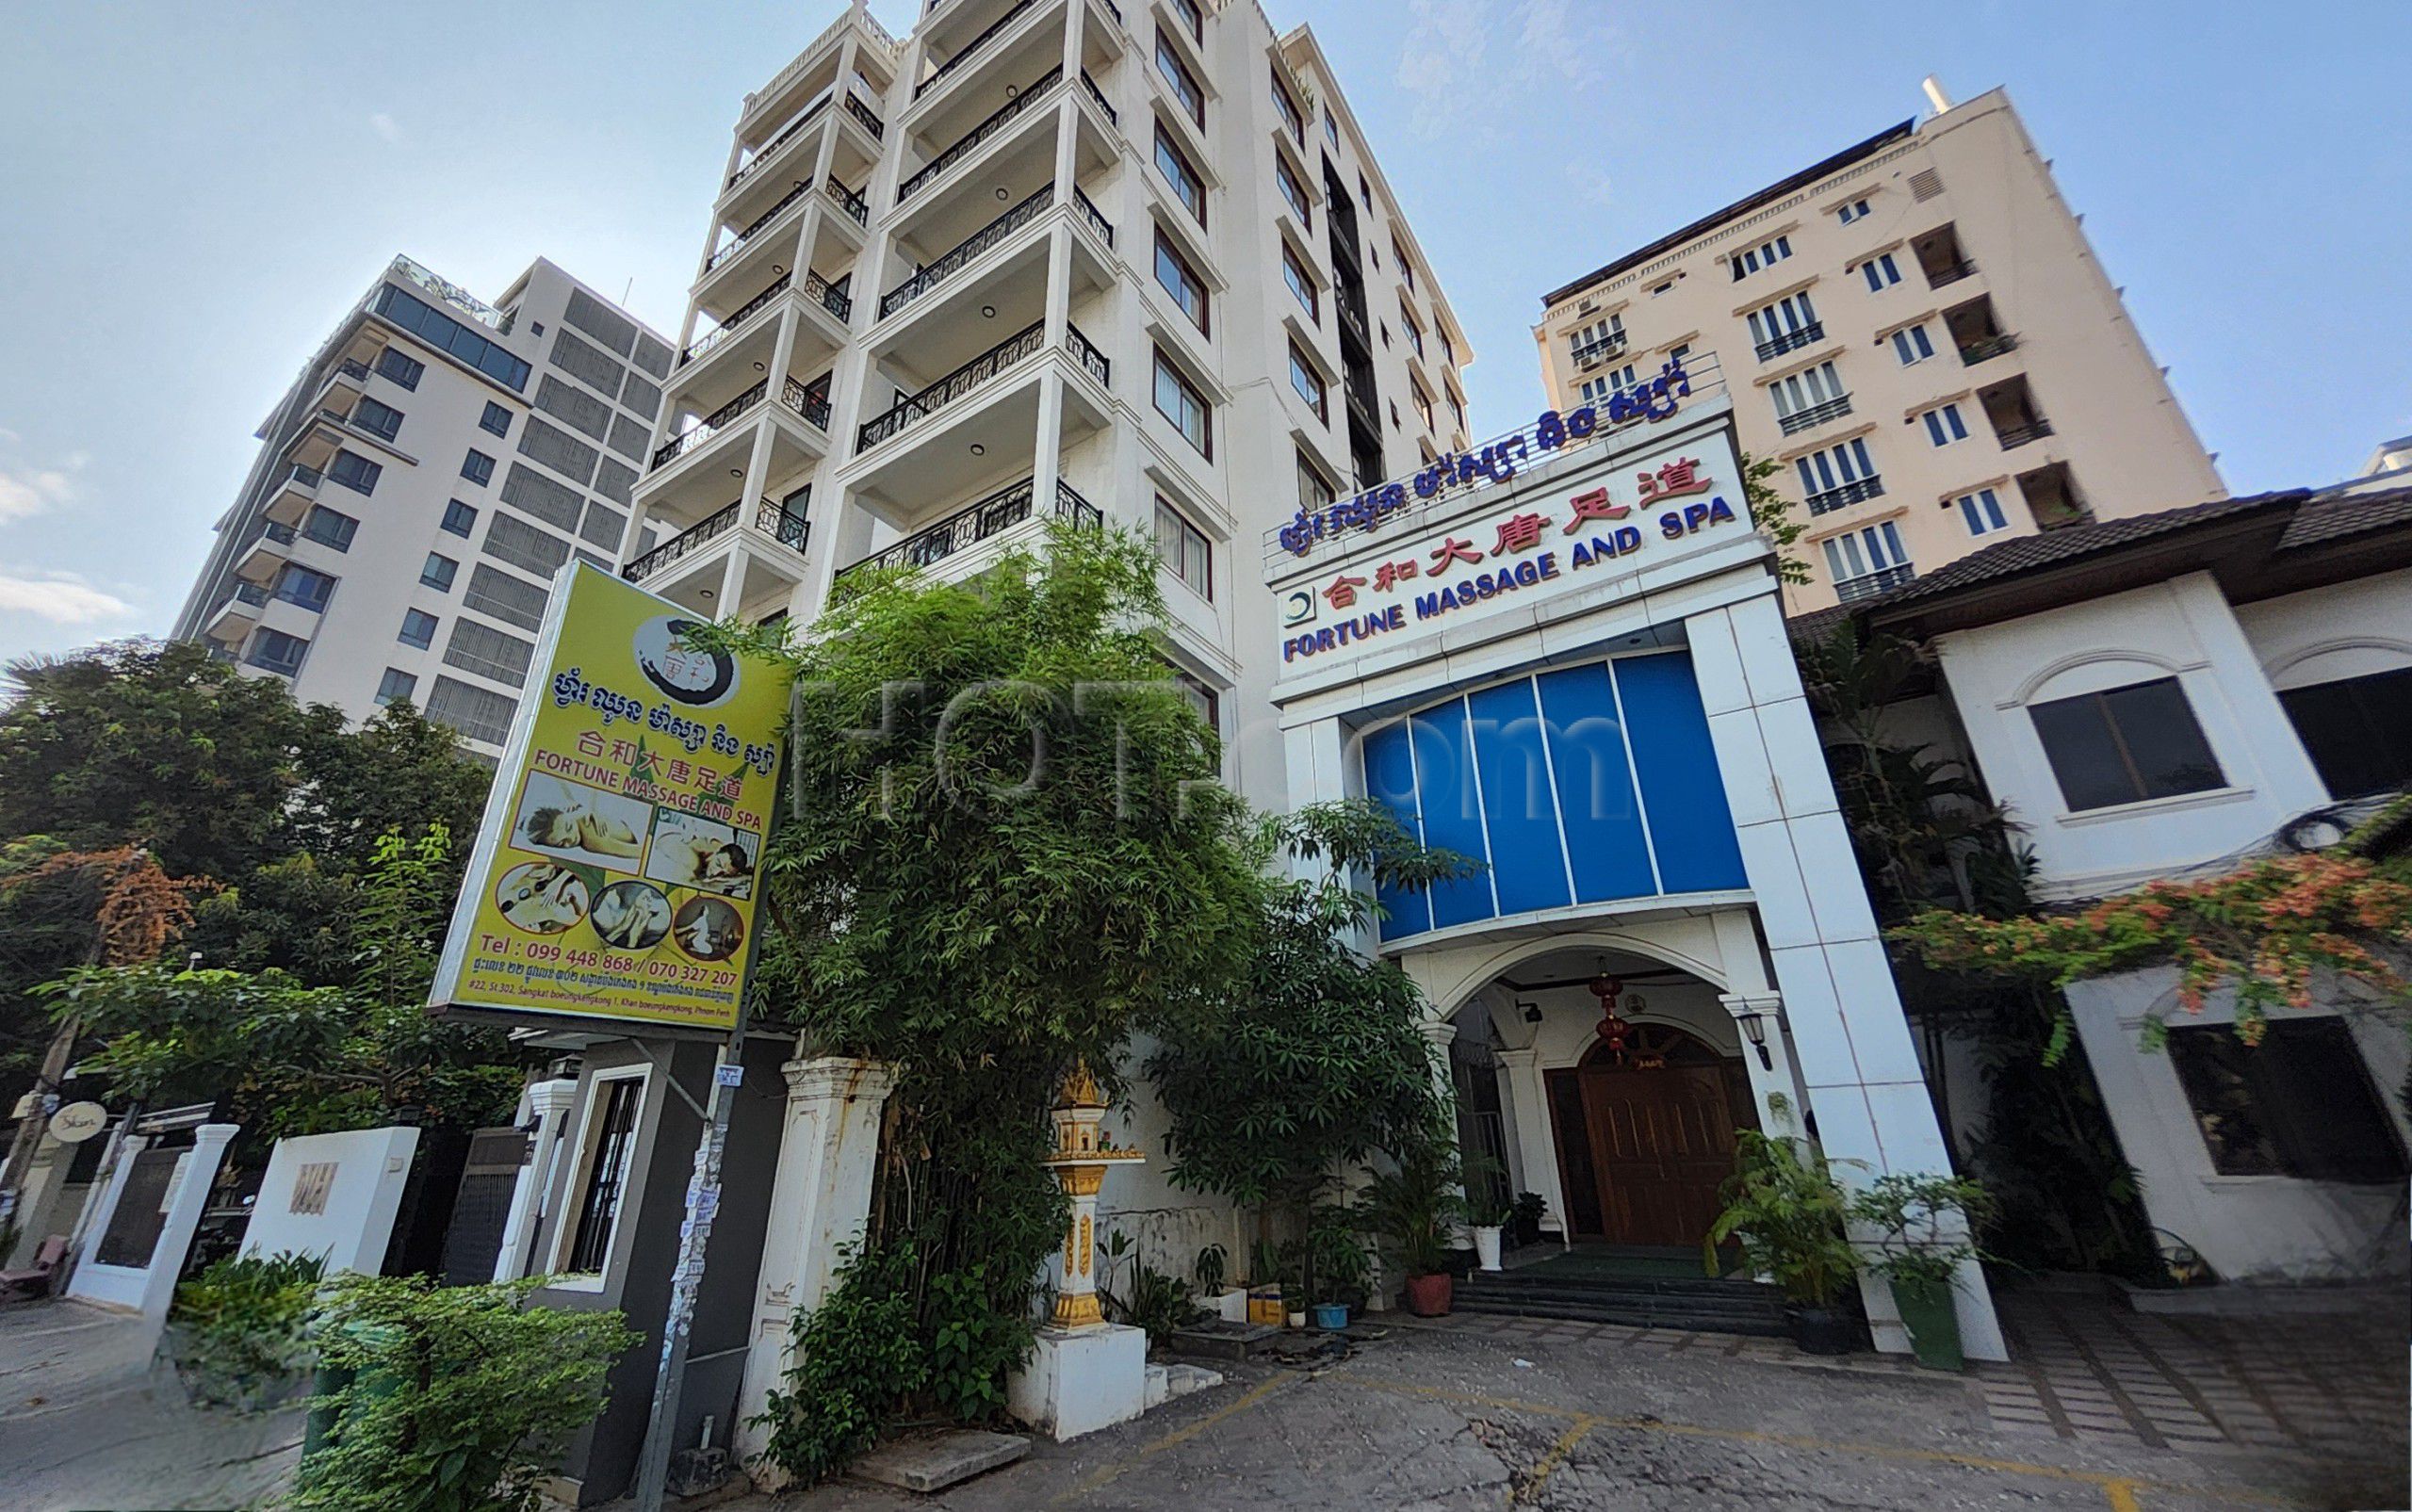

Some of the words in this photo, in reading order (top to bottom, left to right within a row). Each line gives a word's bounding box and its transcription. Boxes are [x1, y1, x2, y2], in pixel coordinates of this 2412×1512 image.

[1323, 456, 1713, 610] 合和大唐足道
[1282, 604, 1408, 663] FORTUNE
[1414, 552, 1561, 623] MASSAGE
[1572, 525, 1642, 571] AND
[1660, 496, 1736, 541] SPA
[534, 749, 619, 789] FORTUNE
[622, 772, 697, 811] MASSAGE
[699, 801, 733, 821] AND
[737, 809, 762, 830] SPA
[578, 730, 743, 801] 合和大唐足道
[481, 934, 511, 954] Tel
[527, 943, 562, 961] 099
[565, 949, 598, 967] 448
[603, 954, 633, 971] 868
[636, 958, 646, 973] /
[649, 961, 677, 978] 070
[680, 966, 709, 982] 327
[711, 969, 738, 986] 207
